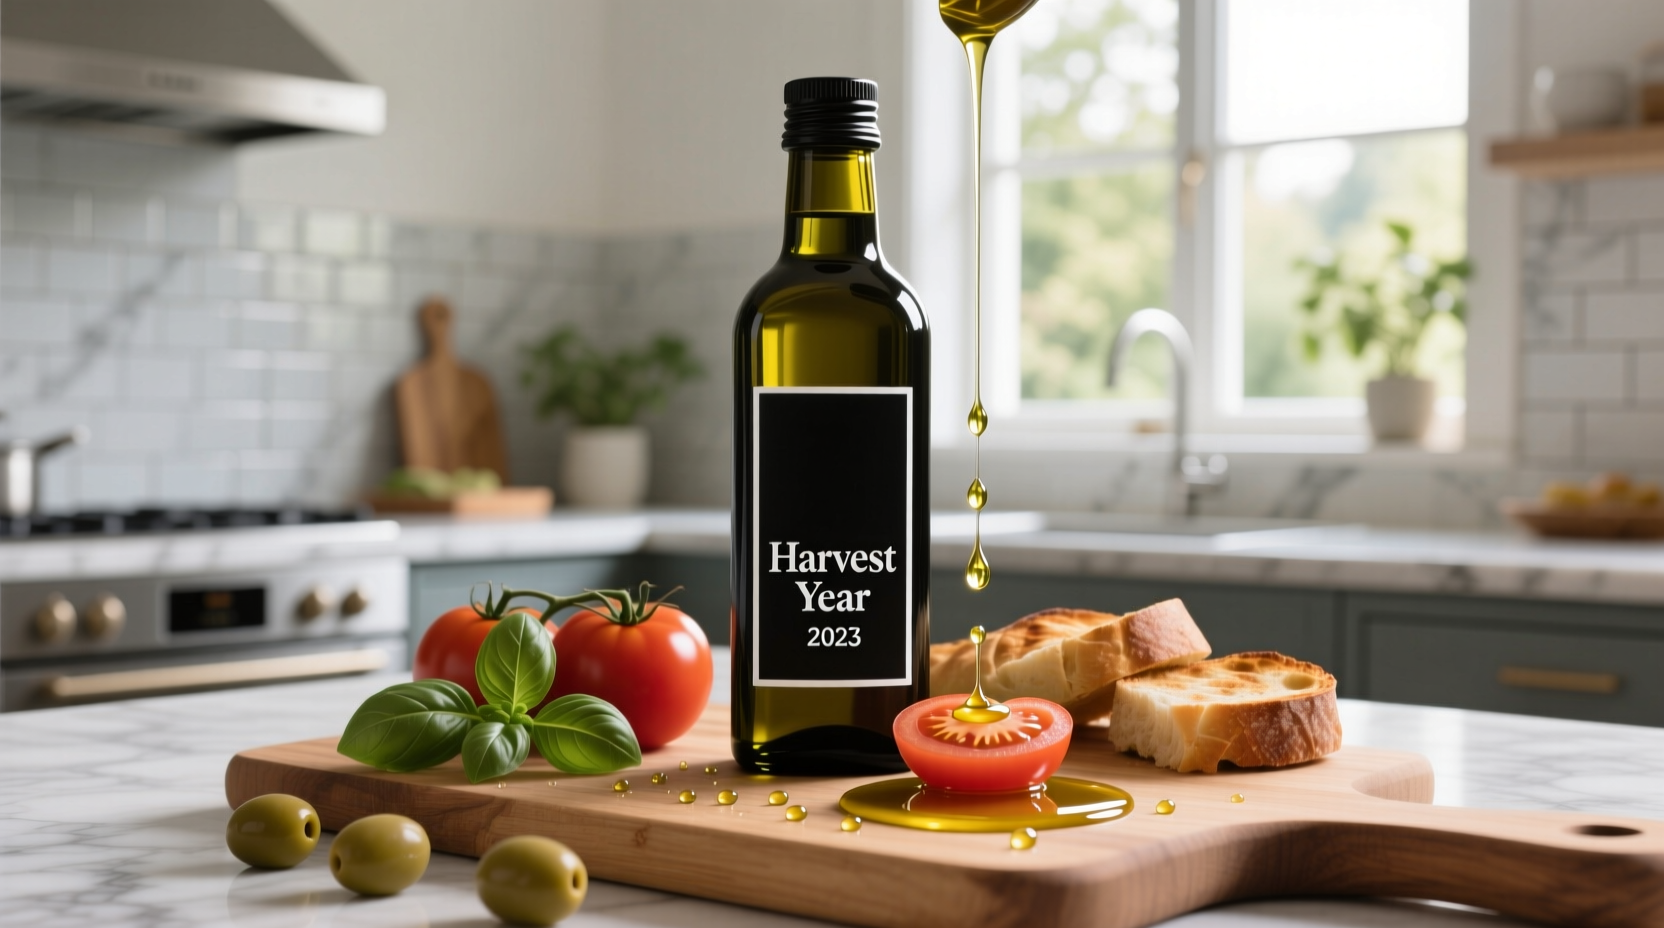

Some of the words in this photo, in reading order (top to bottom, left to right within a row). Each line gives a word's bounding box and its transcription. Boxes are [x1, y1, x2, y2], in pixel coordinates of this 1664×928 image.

[768, 541, 897, 573] Harvest
[794, 581, 871, 612] Year
[807, 626, 862, 647] 2023
